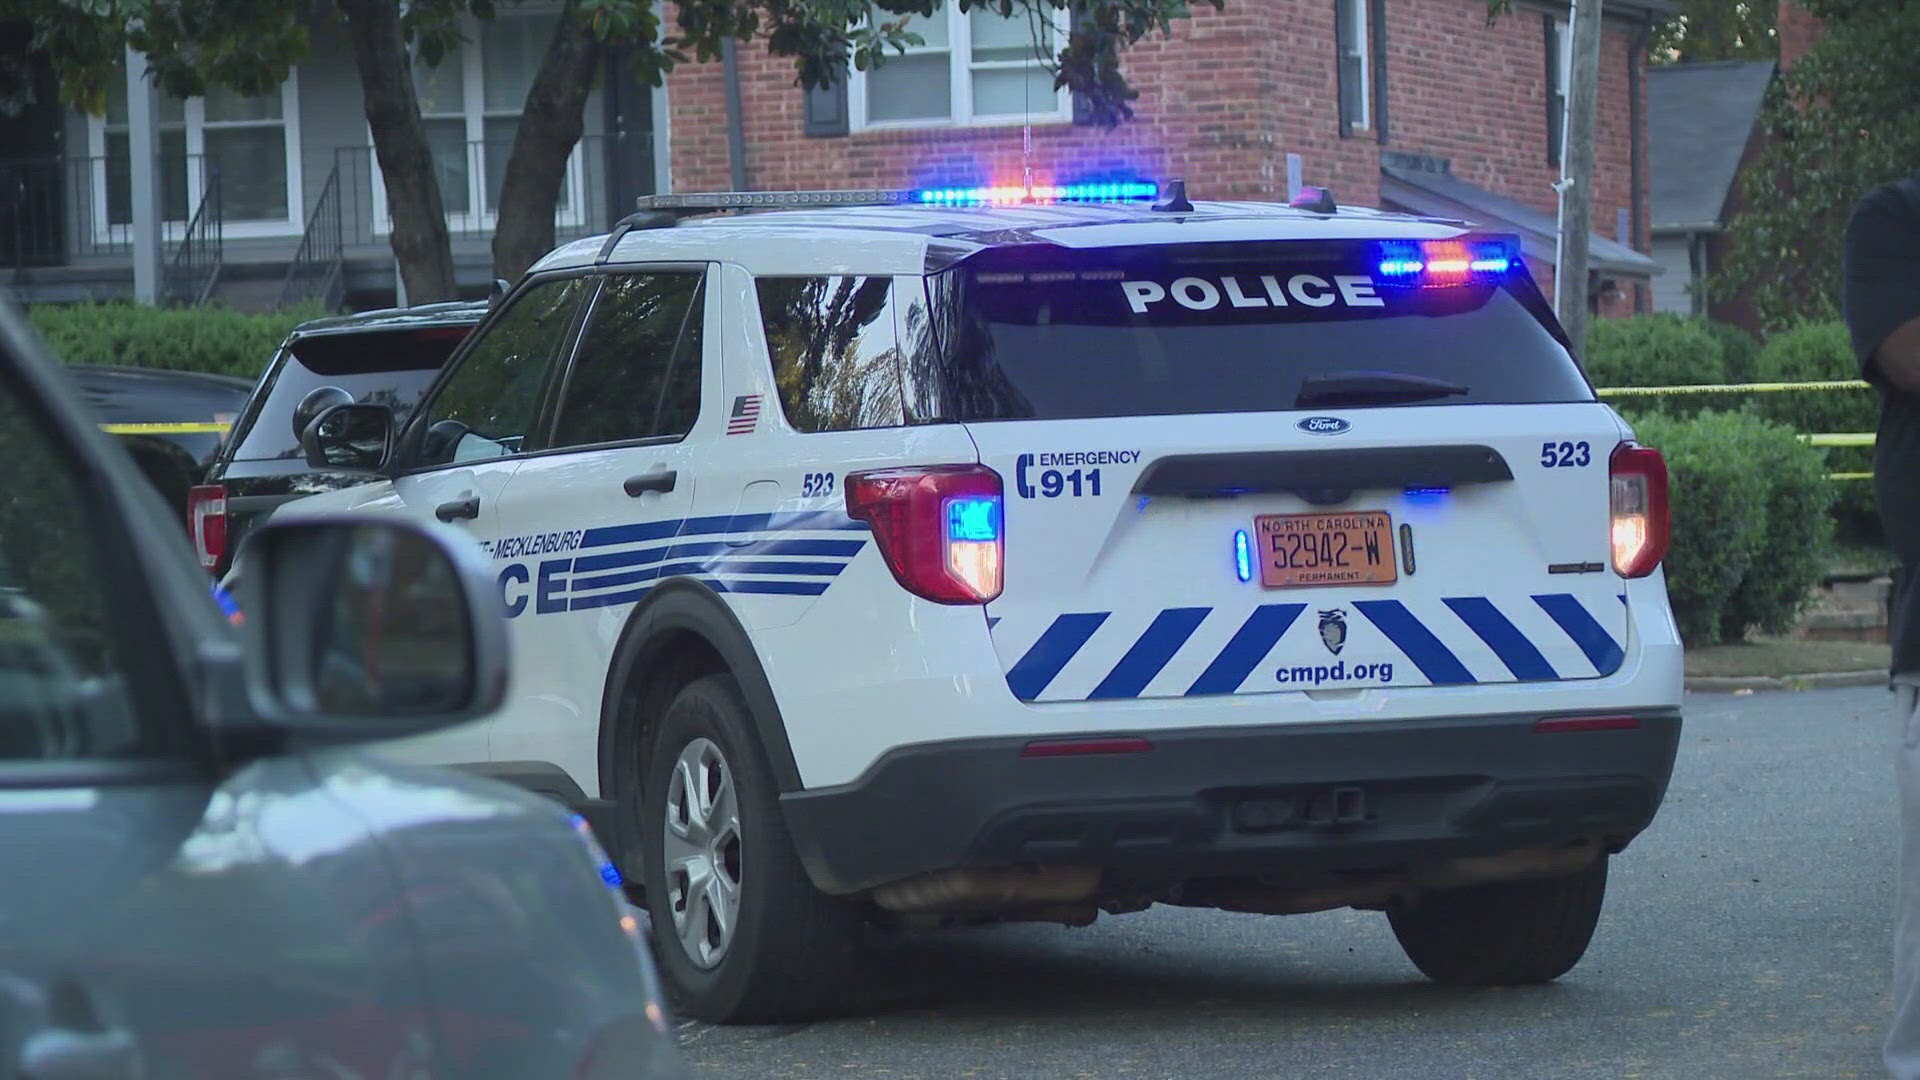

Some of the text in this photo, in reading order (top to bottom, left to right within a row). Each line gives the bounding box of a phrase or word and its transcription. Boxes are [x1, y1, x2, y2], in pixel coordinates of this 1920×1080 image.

[1120, 274, 1385, 314] POLICE
[1308, 418, 1341, 430] Ford
[1039, 450, 1141, 466] EMERGENCY
[1541, 441, 1591, 467] 523
[801, 472, 835, 498] 523
[1040, 468, 1101, 498] 911
[1261, 517, 1385, 532] NORTH CAROLINA
[1271, 530, 1381, 568] 52942-W
[1299, 571, 1360, 582] PERMANENT
[1275, 660, 1393, 686] cmpd.org
